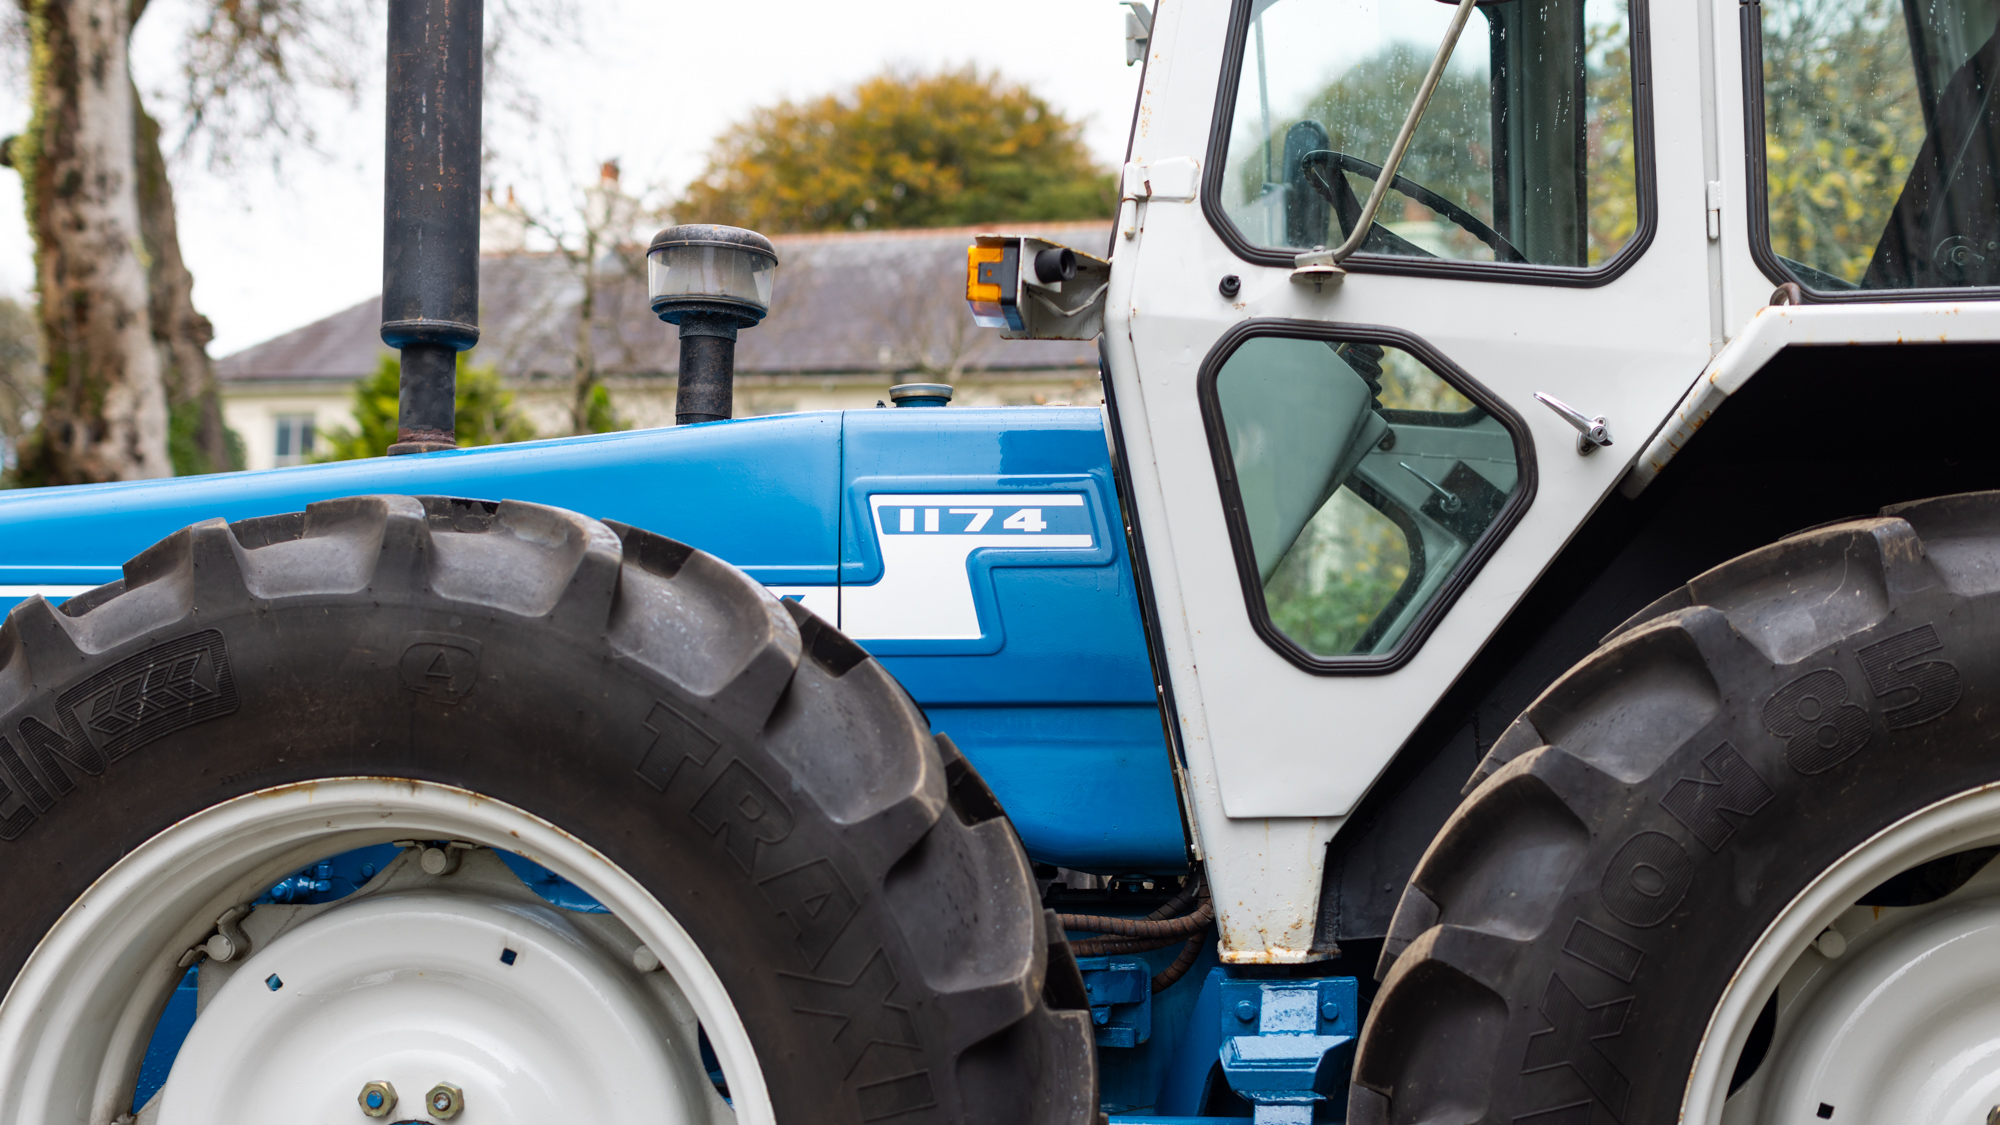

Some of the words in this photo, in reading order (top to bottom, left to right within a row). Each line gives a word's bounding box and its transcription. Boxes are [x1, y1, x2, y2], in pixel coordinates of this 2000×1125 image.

[899, 508, 1047, 532] 1174
[1511, 738, 1777, 1125] XION
[1761, 622, 1964, 776] 85
